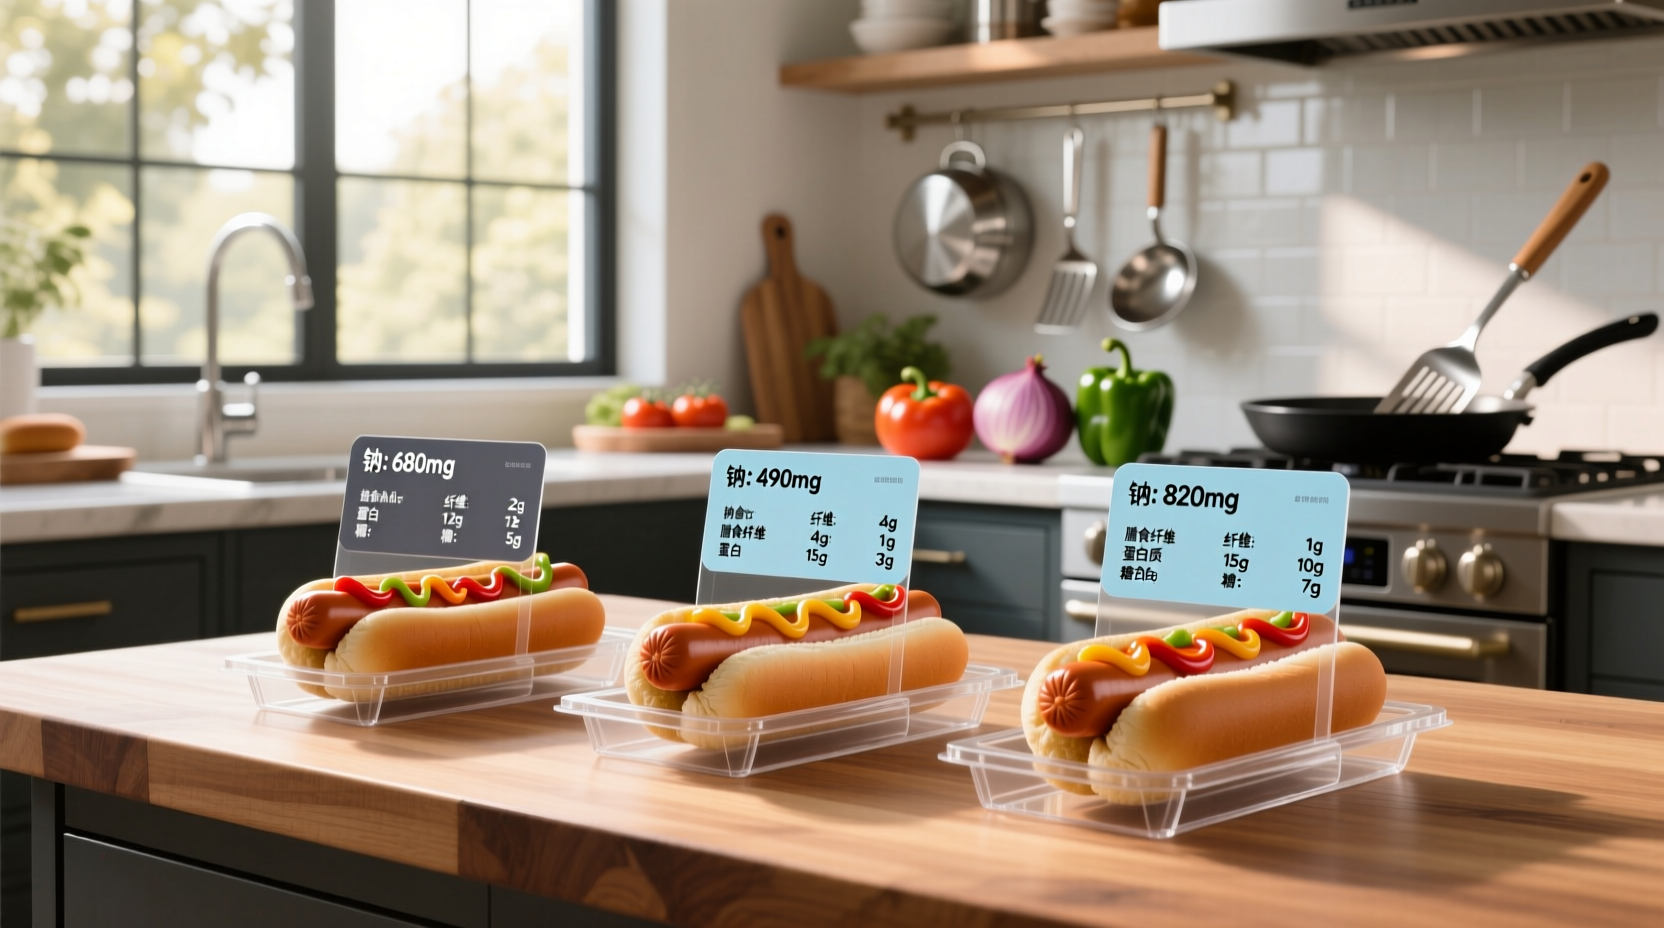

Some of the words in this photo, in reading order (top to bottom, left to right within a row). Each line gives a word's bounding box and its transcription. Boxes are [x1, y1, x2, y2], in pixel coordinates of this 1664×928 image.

[392, 451, 456, 480] 680mg
[726, 464, 753, 488] 钠:
[756, 467, 822, 494] 490mg
[507, 497, 525, 514] 2g
[1128, 480, 1158, 507] 钠:
[1163, 483, 1240, 515] 820mg
[442, 512, 463, 528] 12g
[878, 514, 898, 532] 4g
[505, 531, 522, 549] 5g
[879, 534, 895, 551] 1g
[1305, 537, 1323, 555] 1g
[806, 548, 828, 567] 15g
[875, 552, 894, 570] 3g
[1223, 553, 1249, 573] 15g
[1297, 558, 1324, 577] 10g
[1301, 579, 1321, 598] 7g
